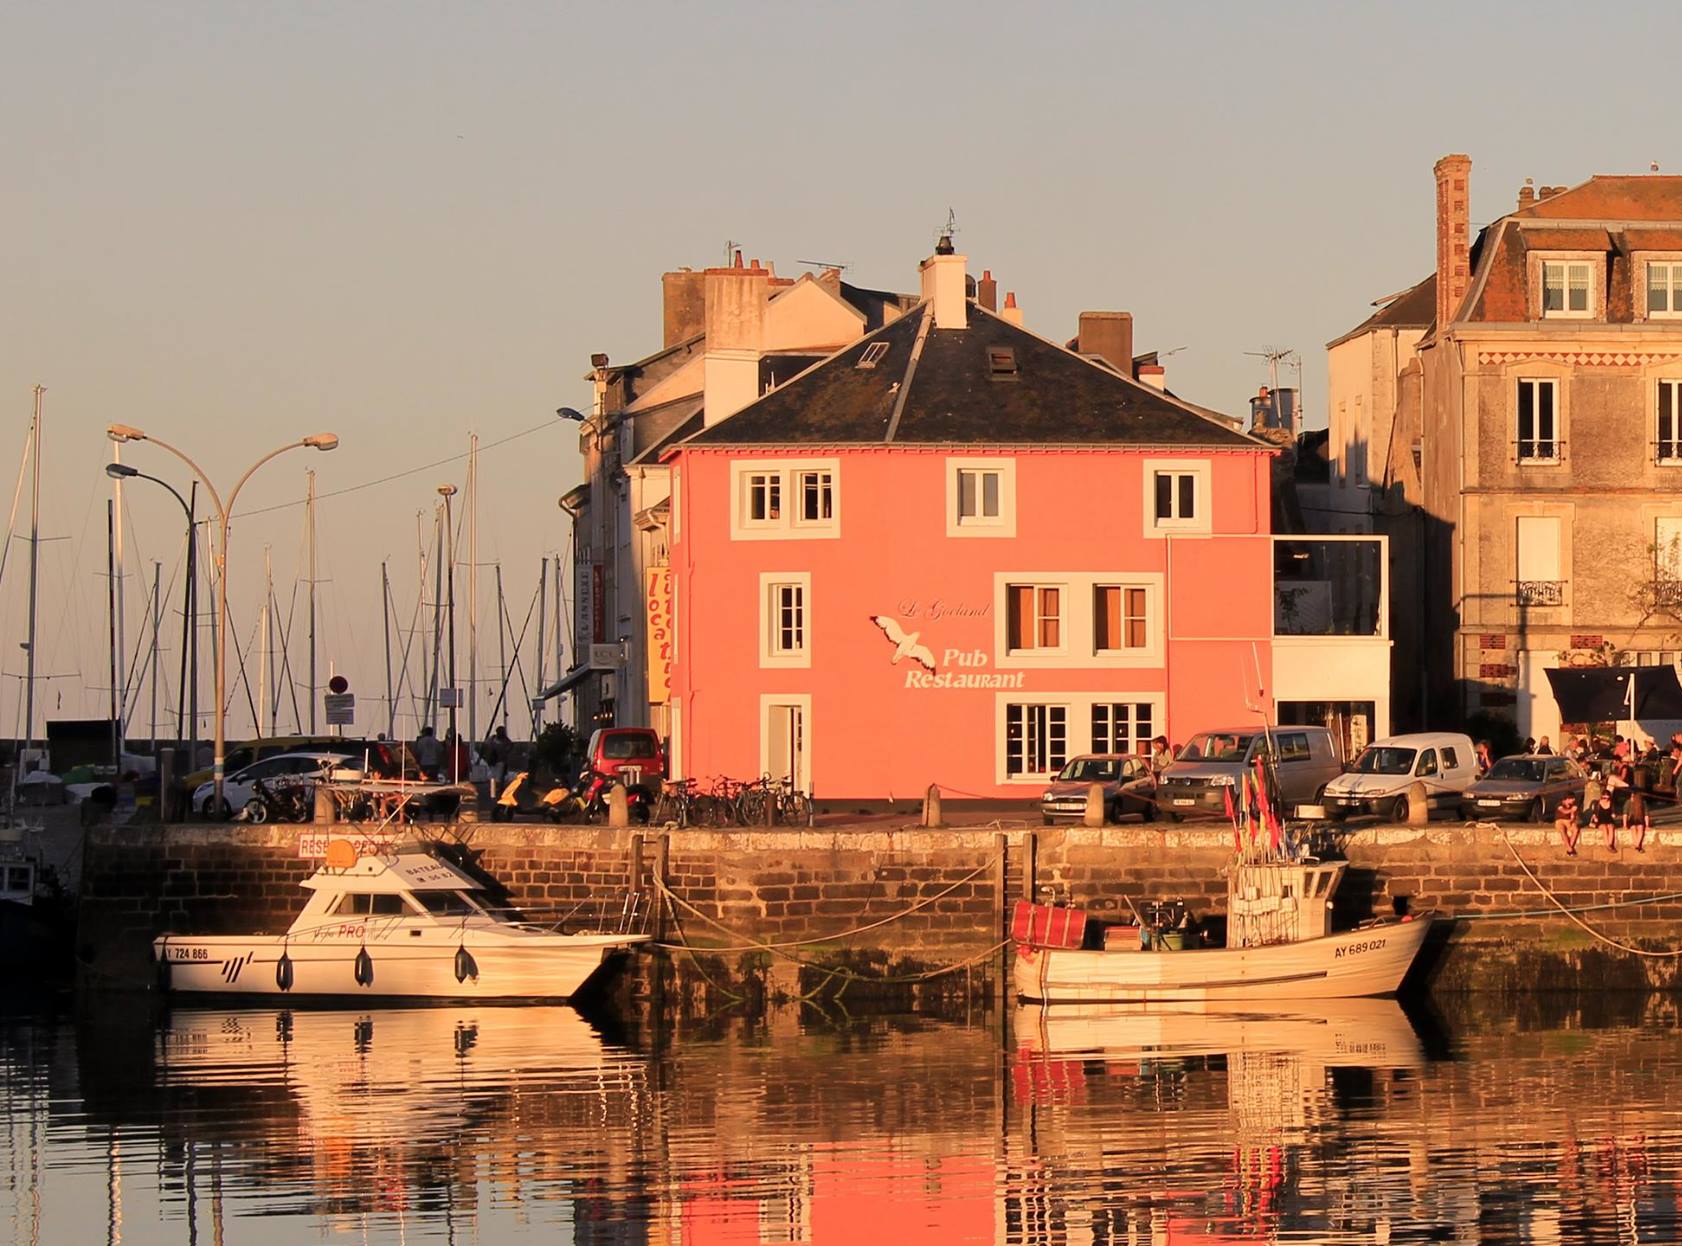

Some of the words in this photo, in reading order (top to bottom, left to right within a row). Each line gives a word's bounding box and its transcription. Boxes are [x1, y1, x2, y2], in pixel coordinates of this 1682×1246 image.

[648, 573, 671, 702] locatio
[943, 649, 988, 667] Pub
[904, 670, 1025, 689] Restaurant
[175, 948, 190, 959] 724
[192, 948, 208, 959] 866
[1335, 946, 1347, 959] AY
[1349, 942, 1368, 955] 689
